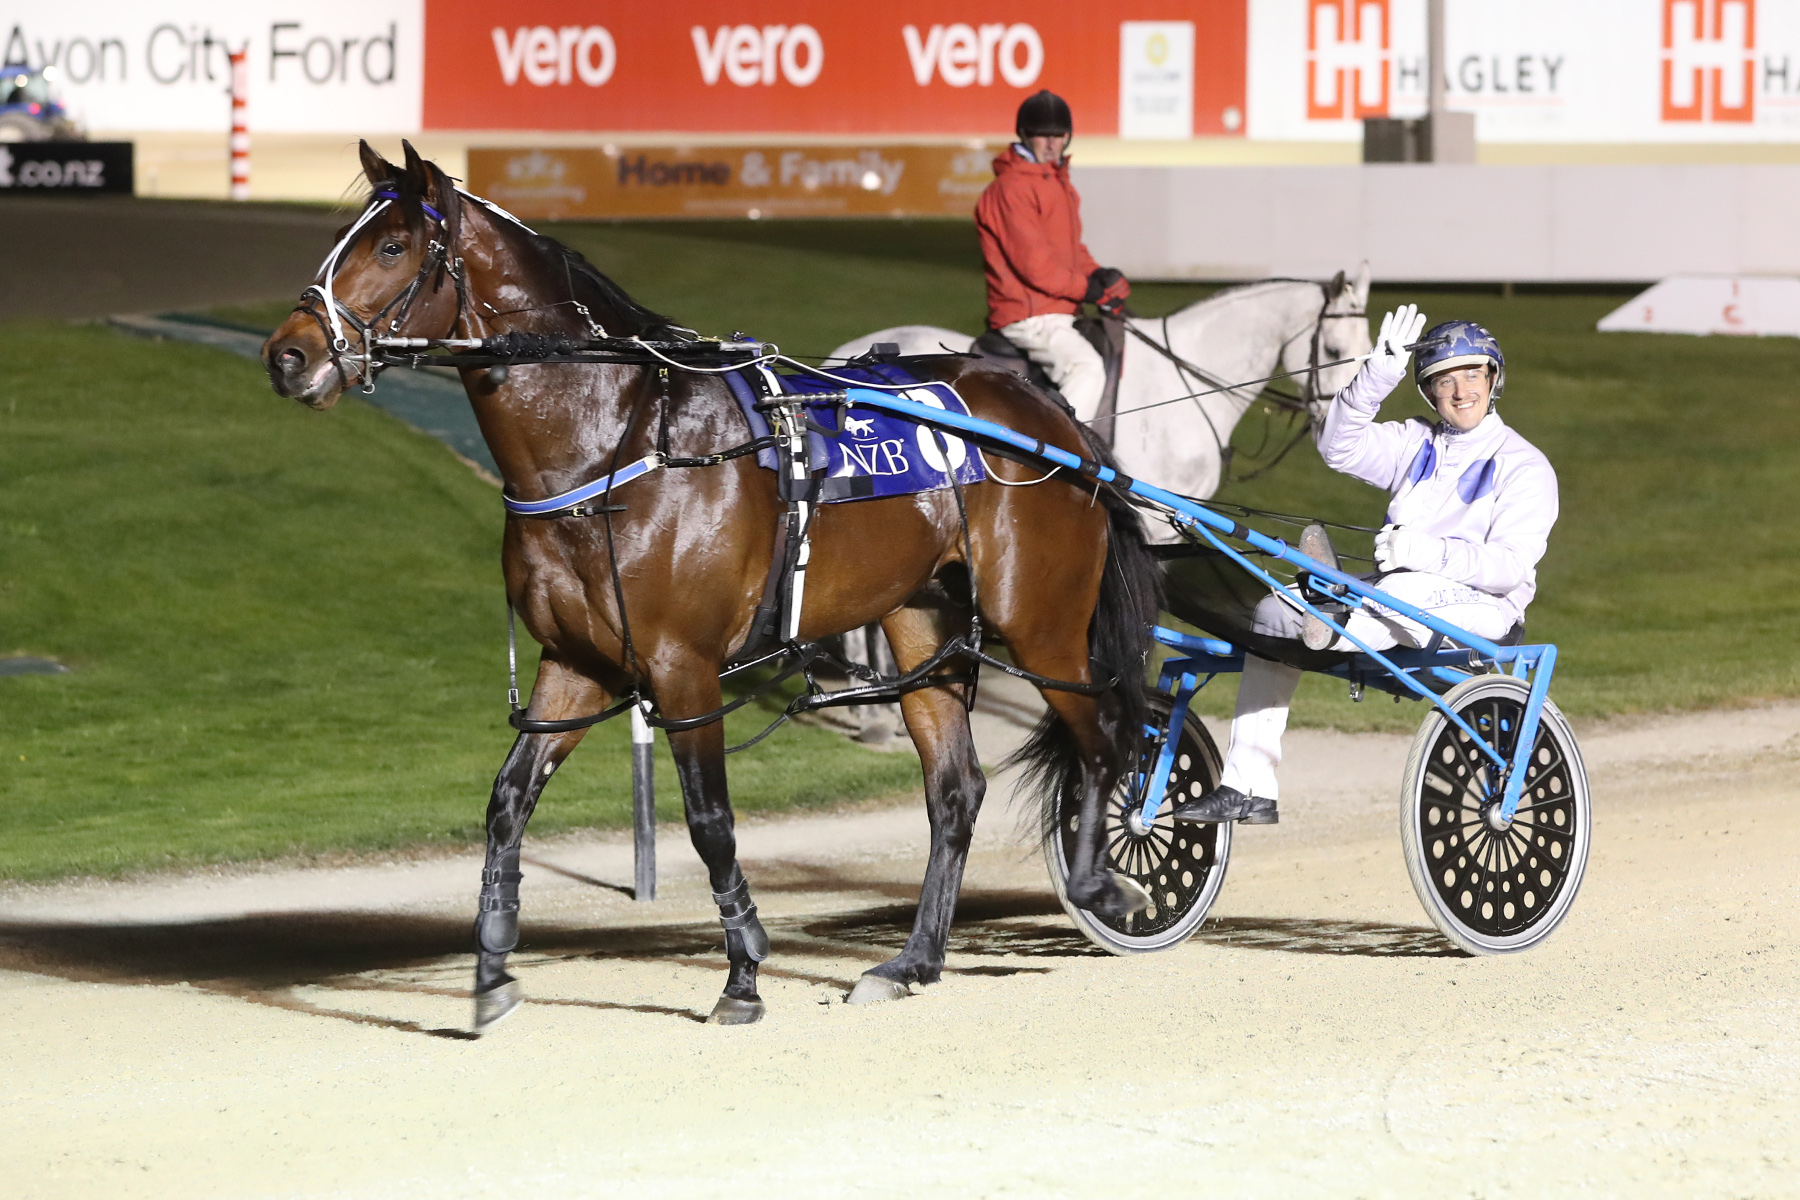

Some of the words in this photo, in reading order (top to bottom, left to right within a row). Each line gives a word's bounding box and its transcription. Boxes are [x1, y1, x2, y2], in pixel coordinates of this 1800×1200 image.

[2, 24, 126, 84] Avon
[147, 24, 249, 94] City
[269, 22, 397, 85] Ford
[492, 26, 616, 86] vero
[692, 25, 824, 87] vero
[902, 24, 1044, 87] vero
[1398, 55, 1564, 92] HGLEY
[618, 156, 731, 186] Home
[741, 152, 770, 187] &
[780, 152, 904, 194] Family
[839, 439, 909, 475] NZB
